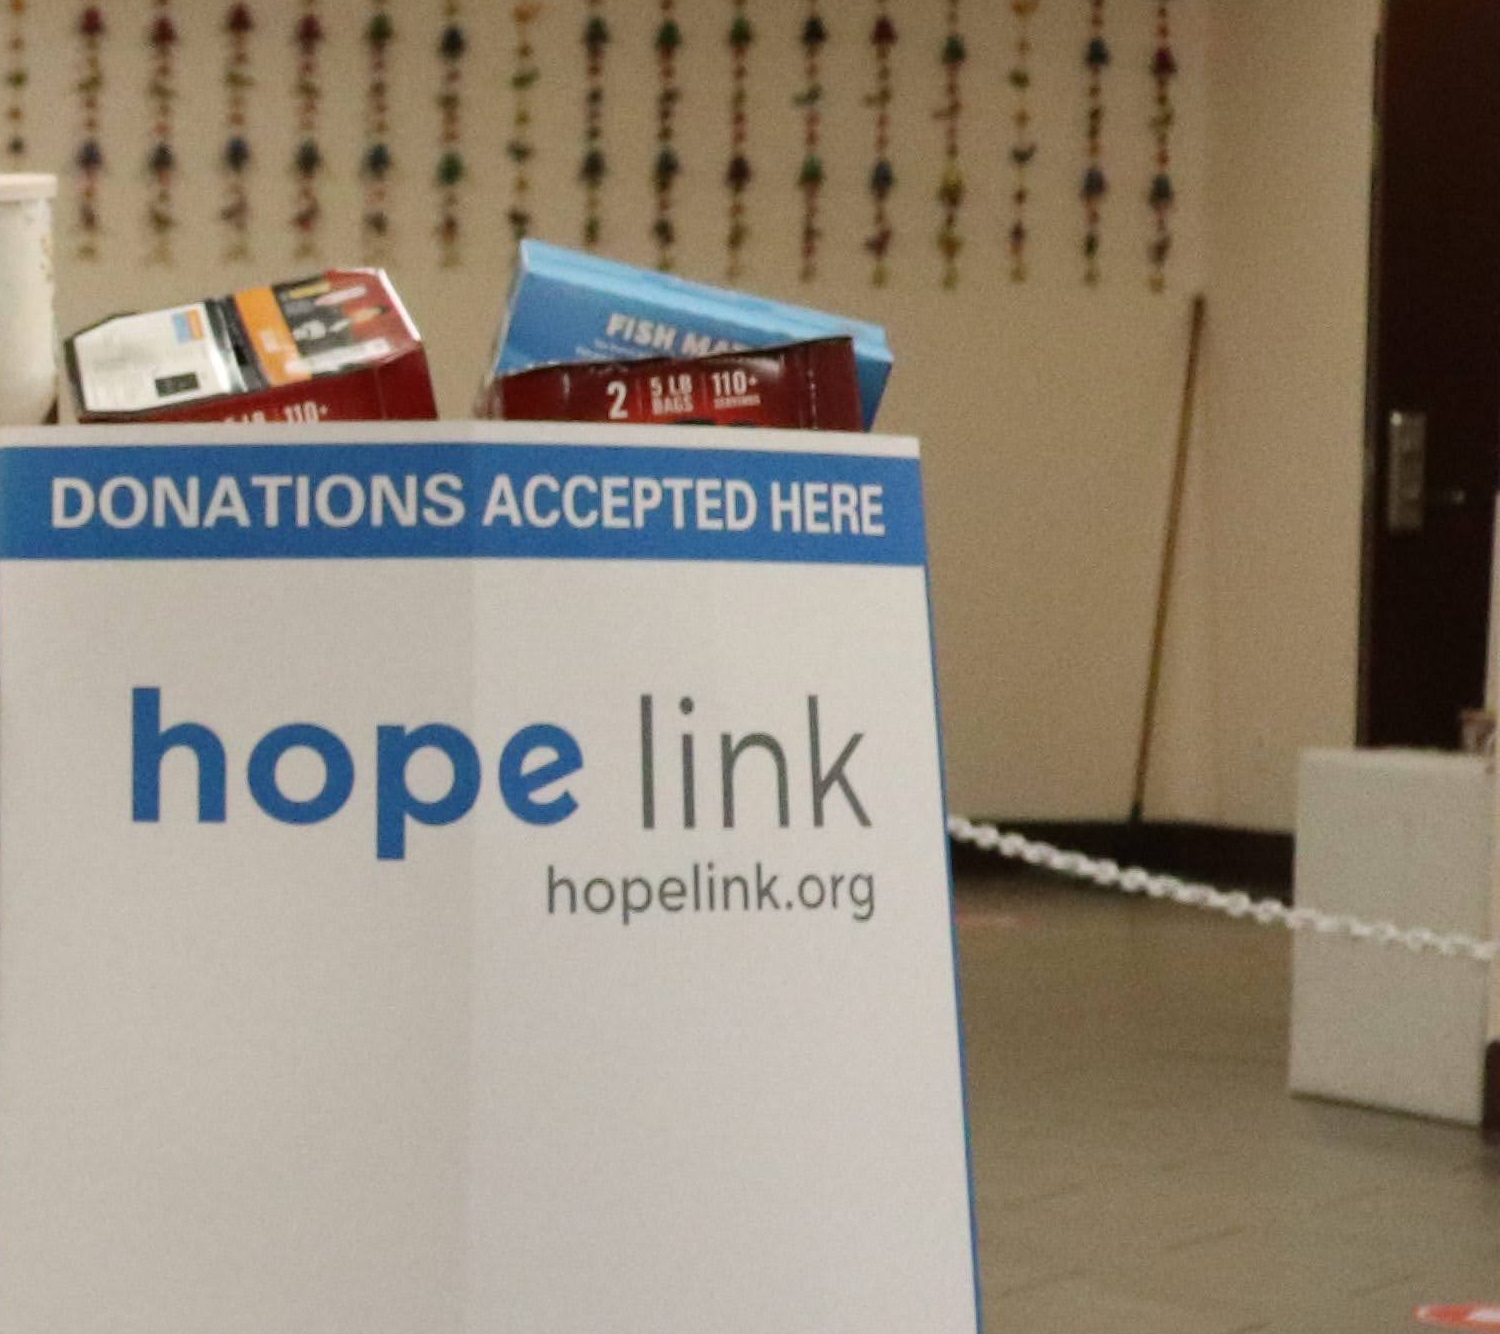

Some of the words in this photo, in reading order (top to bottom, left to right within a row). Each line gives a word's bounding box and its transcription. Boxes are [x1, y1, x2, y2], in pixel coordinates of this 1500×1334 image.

[606, 313, 677, 351] FISH
[606, 380, 629, 420] 2
[650, 375, 663, 398] 5
[668, 373, 693, 395] LB
[711, 370, 759, 397] 110+
[651, 393, 694, 416] BAGS
[50, 473, 466, 530] DONATIONS
[482, 473, 758, 532] ACCEPTED
[771, 482, 886, 537] HERE
[130, 687, 584, 860] hope
[637, 693, 872, 830] link
[545, 861, 877, 927] hopelink.org
